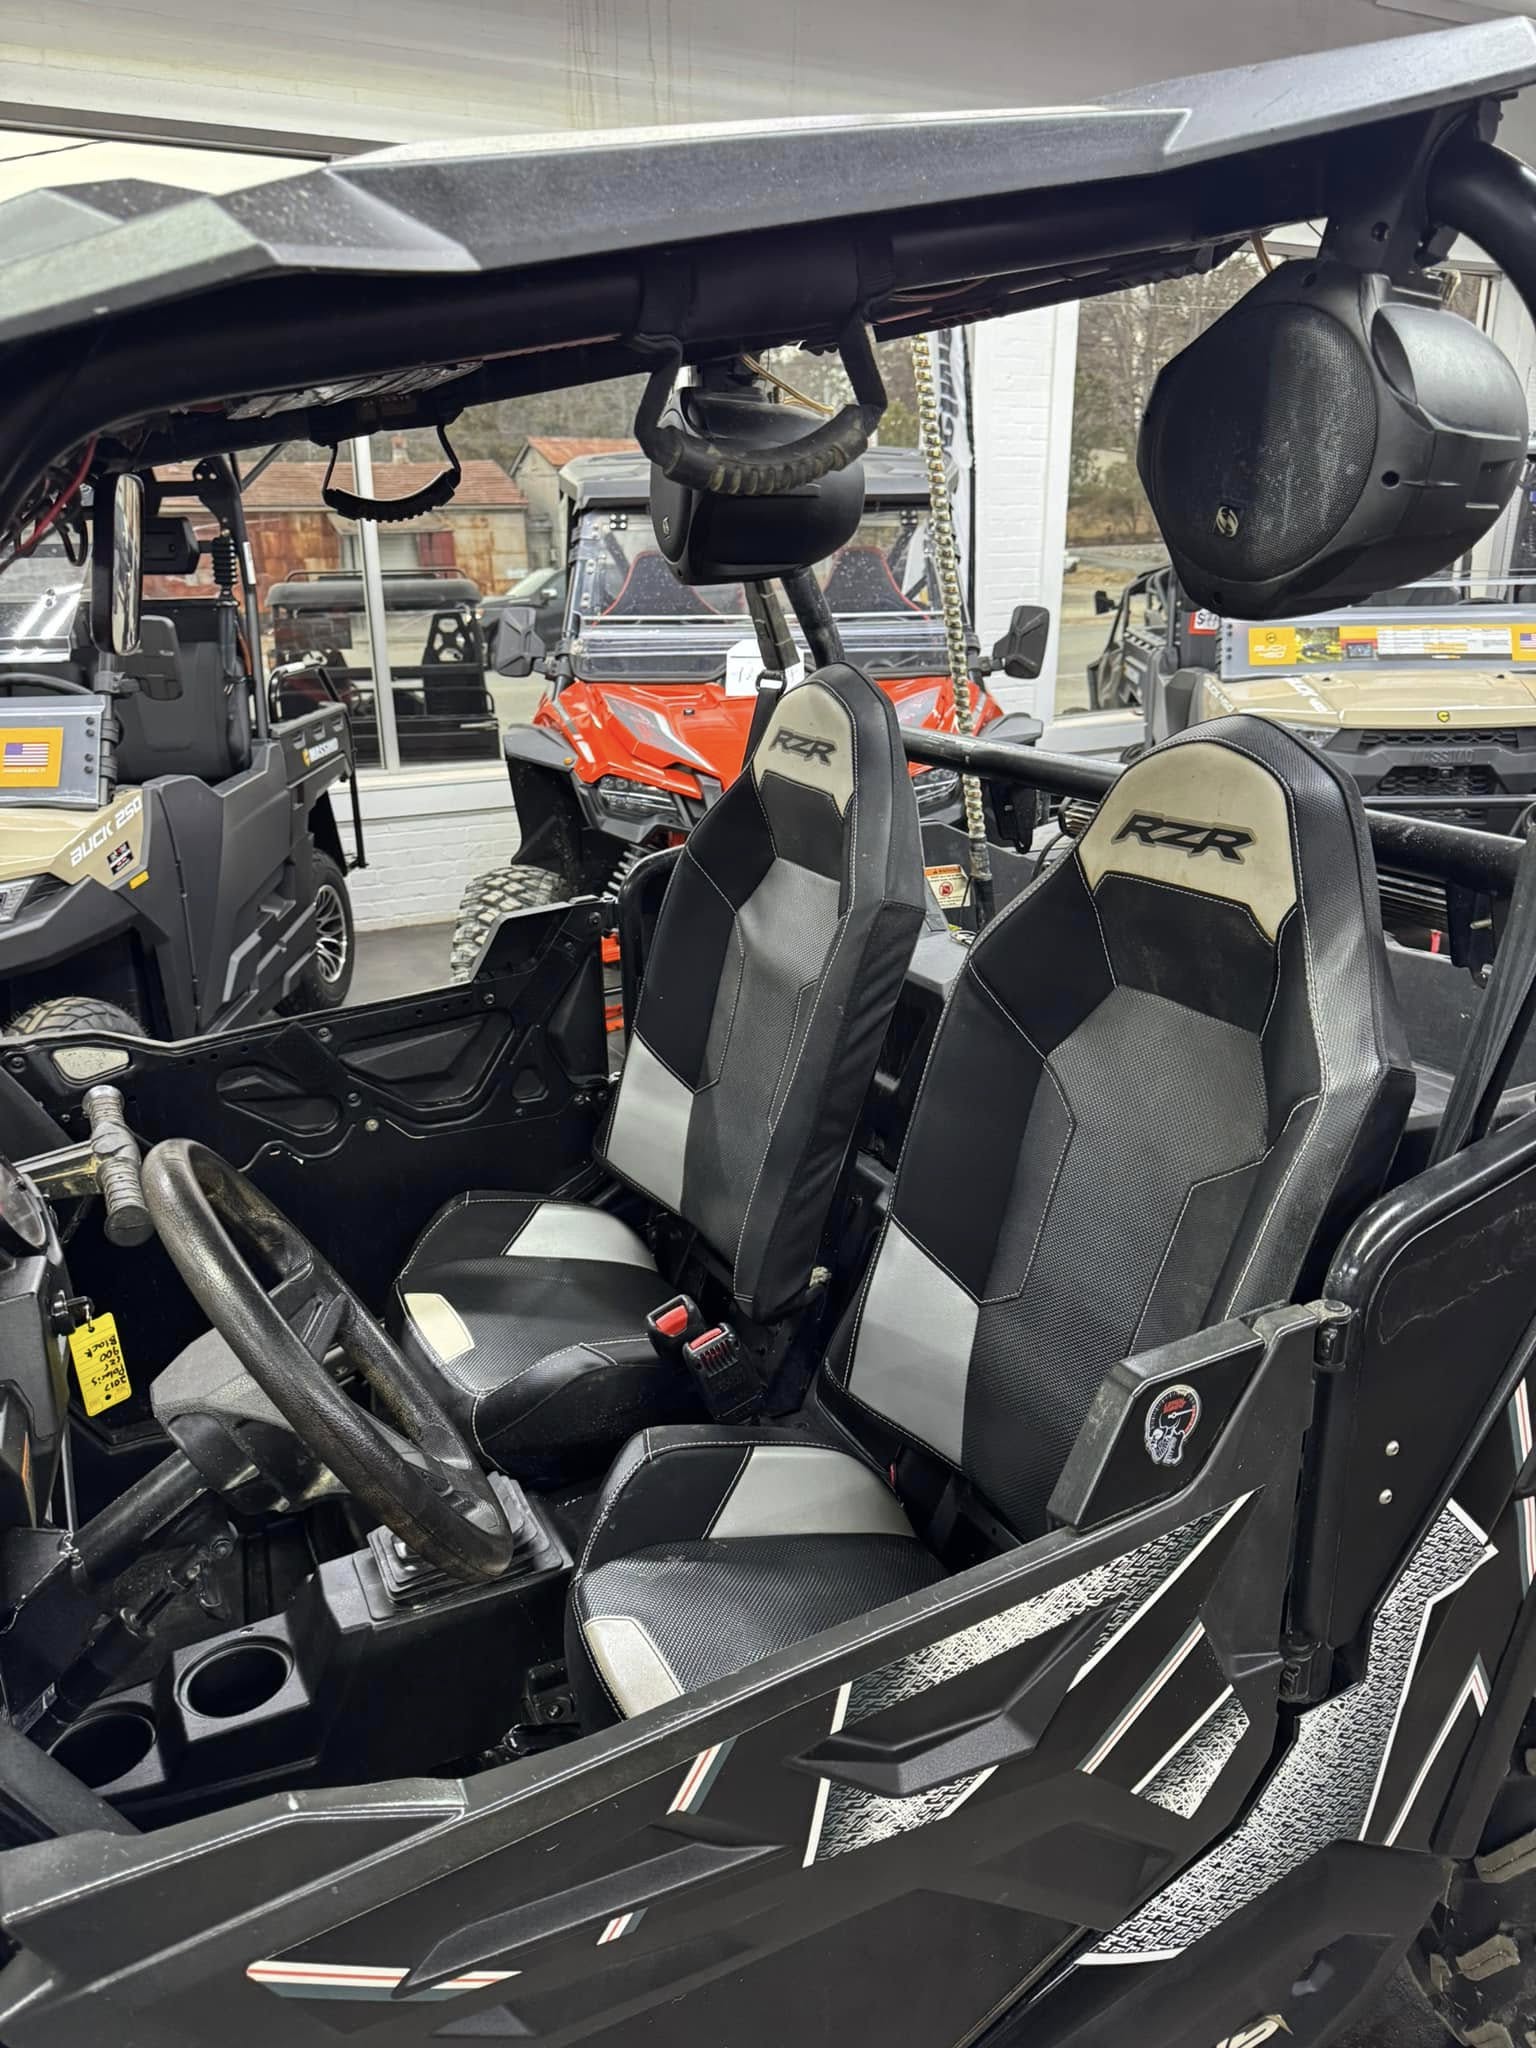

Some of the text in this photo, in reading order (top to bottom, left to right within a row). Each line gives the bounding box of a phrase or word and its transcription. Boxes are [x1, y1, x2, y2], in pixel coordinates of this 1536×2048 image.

[769, 727, 837, 766] RZR
[70, 820, 114, 868] BUCK
[114, 796, 143, 830] 250
[1112, 811, 1256, 864] RZR
[84, 1335, 118, 1358] Black
[100, 1347, 120, 1362] 900
[91, 1364, 125, 1386] Polaris
[104, 1375, 127, 1392] 2017
